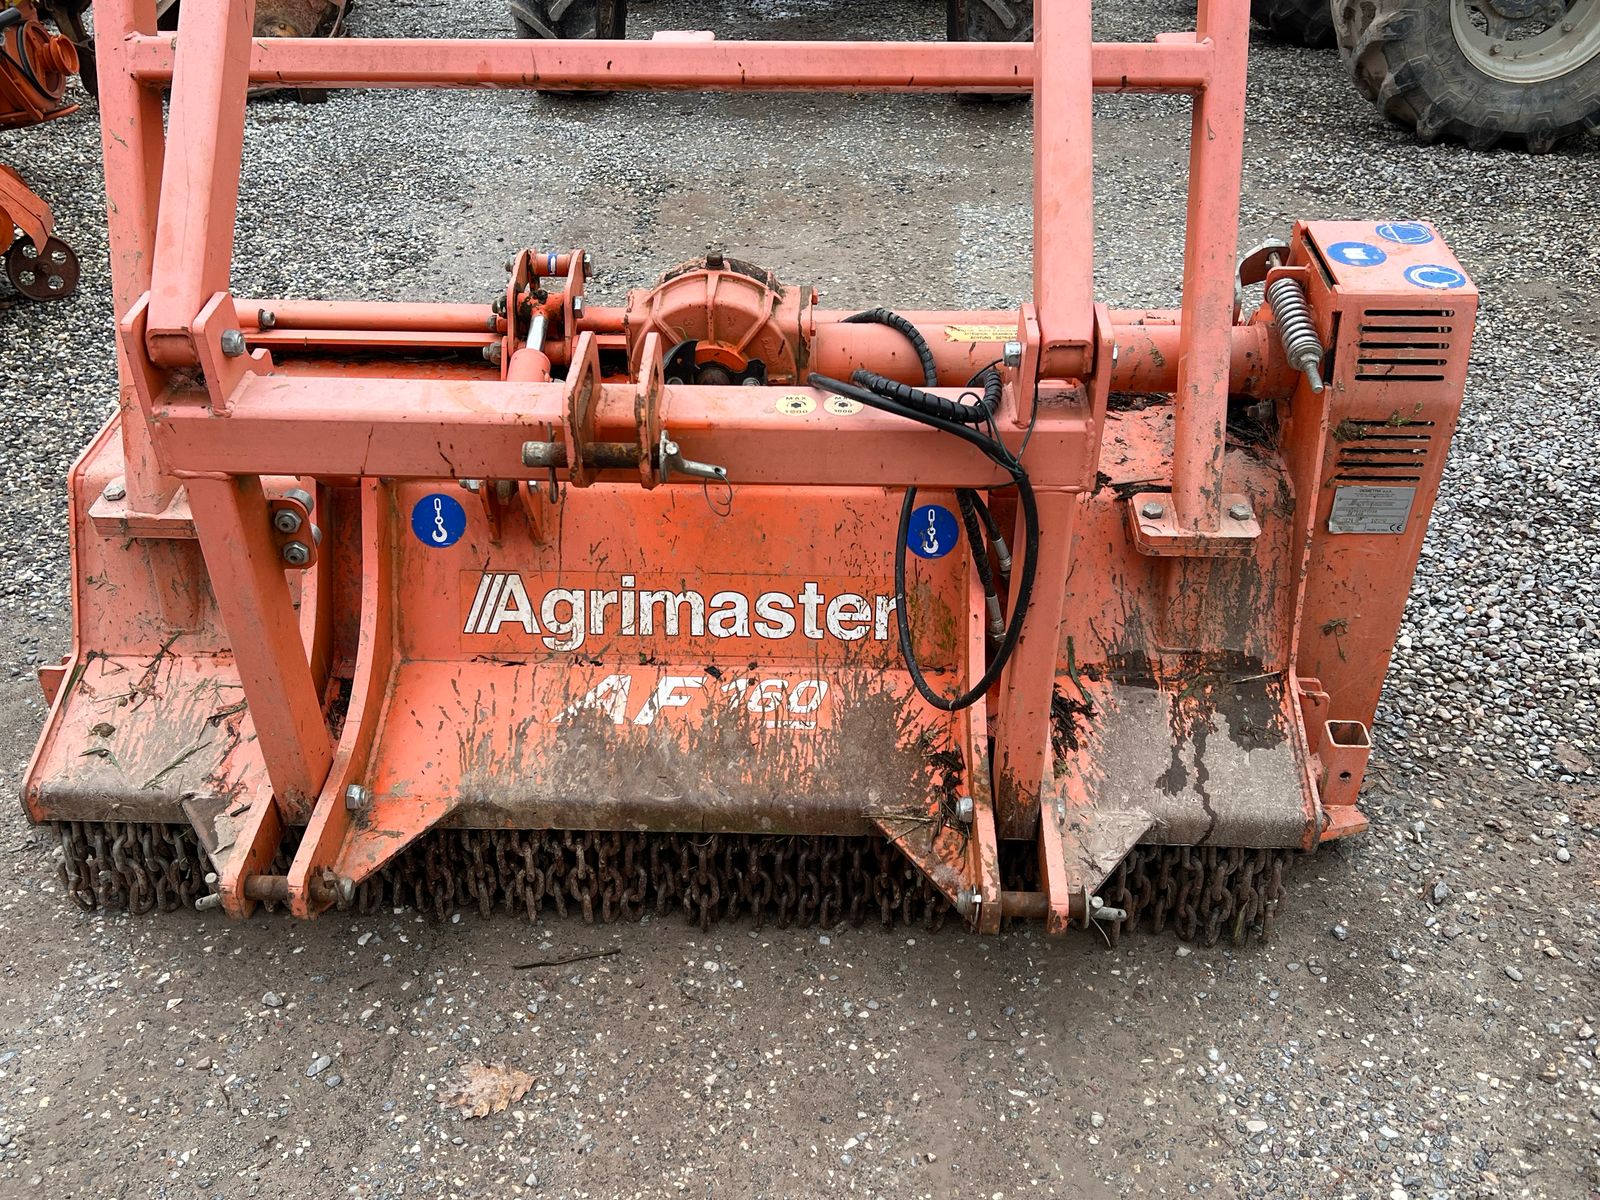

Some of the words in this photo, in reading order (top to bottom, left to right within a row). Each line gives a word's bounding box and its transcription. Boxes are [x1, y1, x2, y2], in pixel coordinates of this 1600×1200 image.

[486, 573, 900, 652] Agrimaster
[549, 674, 708, 726] AF
[719, 679, 829, 716] 160
